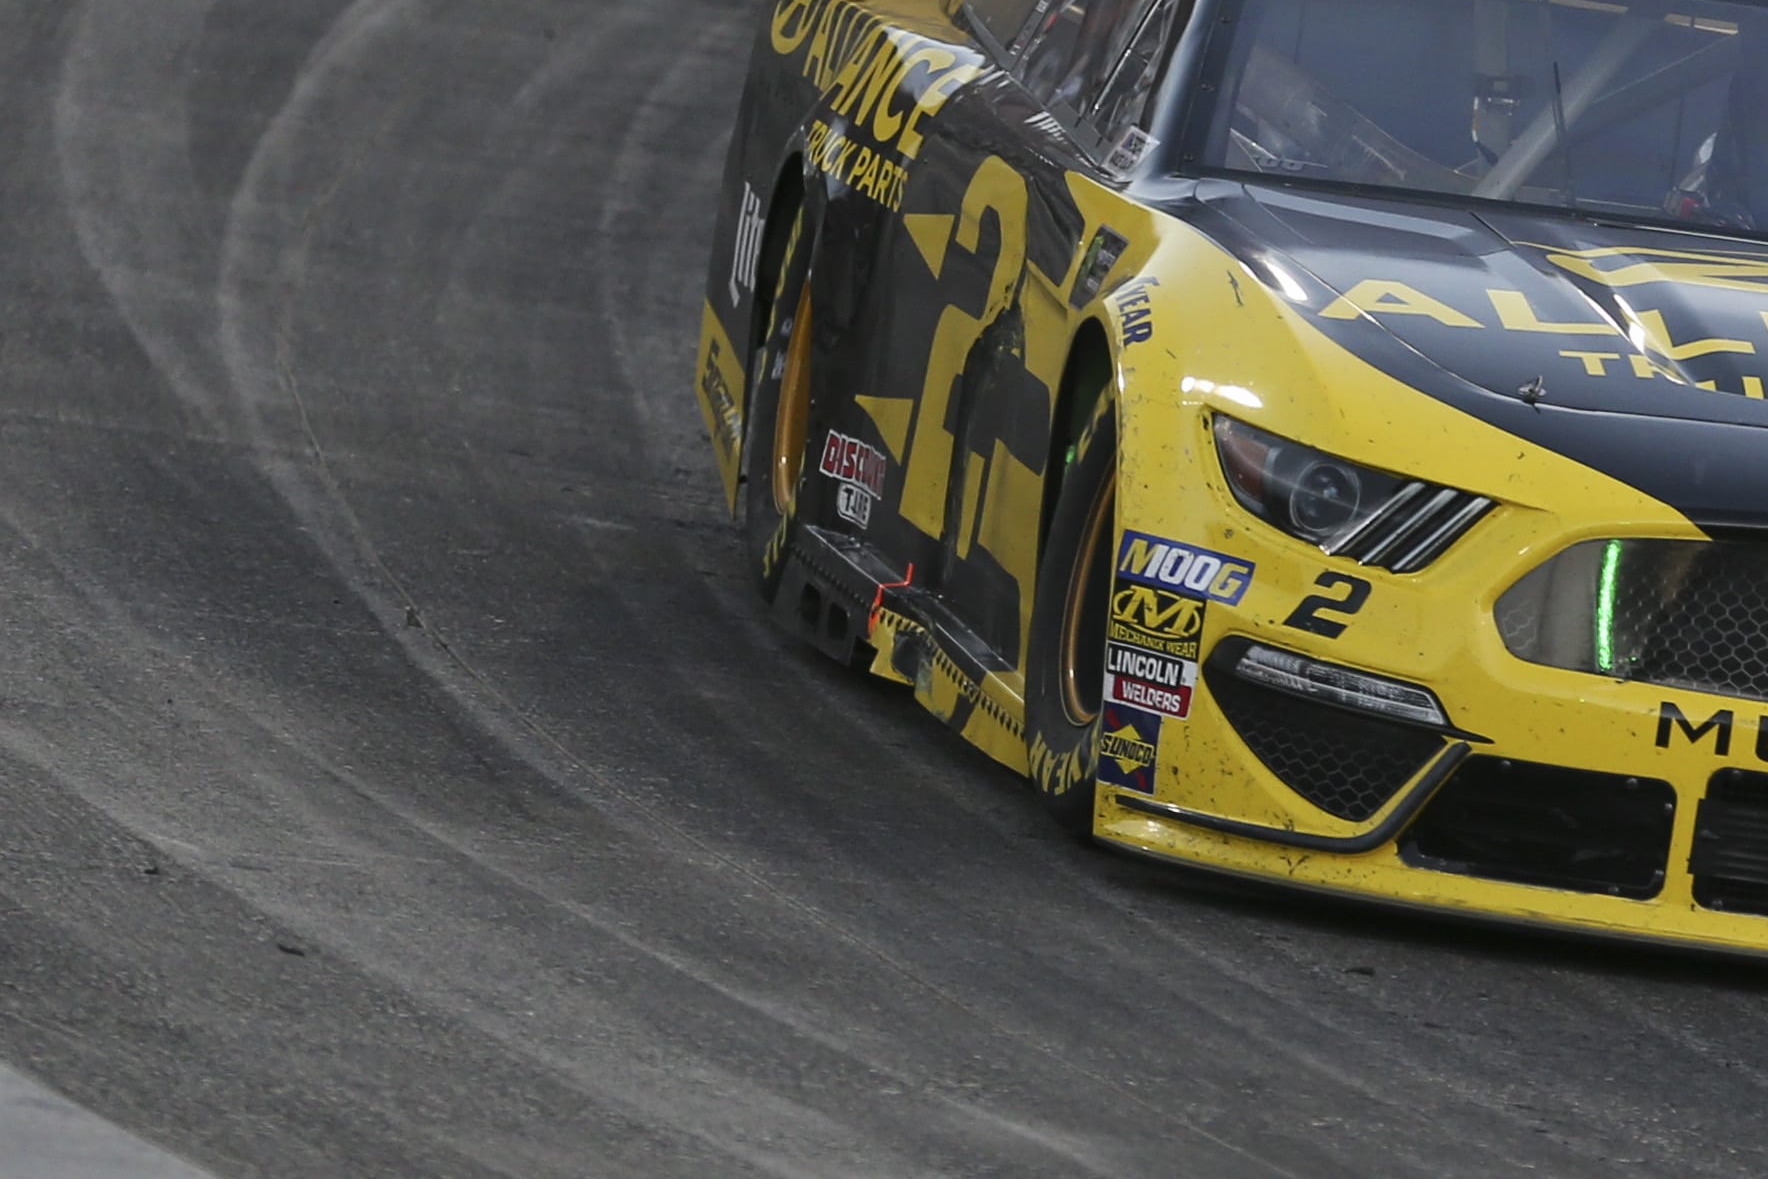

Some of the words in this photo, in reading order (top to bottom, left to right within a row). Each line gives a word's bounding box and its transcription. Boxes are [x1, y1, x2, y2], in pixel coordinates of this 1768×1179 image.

[807, 120, 858, 180] TRUCK
[846, 146, 909, 212] PARTS
[1119, 538, 1249, 598] MOOG
[1283, 570, 1373, 639] 2
[1107, 648, 1179, 687] LINCOLN
[1166, 641, 1197, 659] WEAR
[1122, 680, 1181, 713] WELDERS
[1101, 735, 1153, 764] SUNOCO
